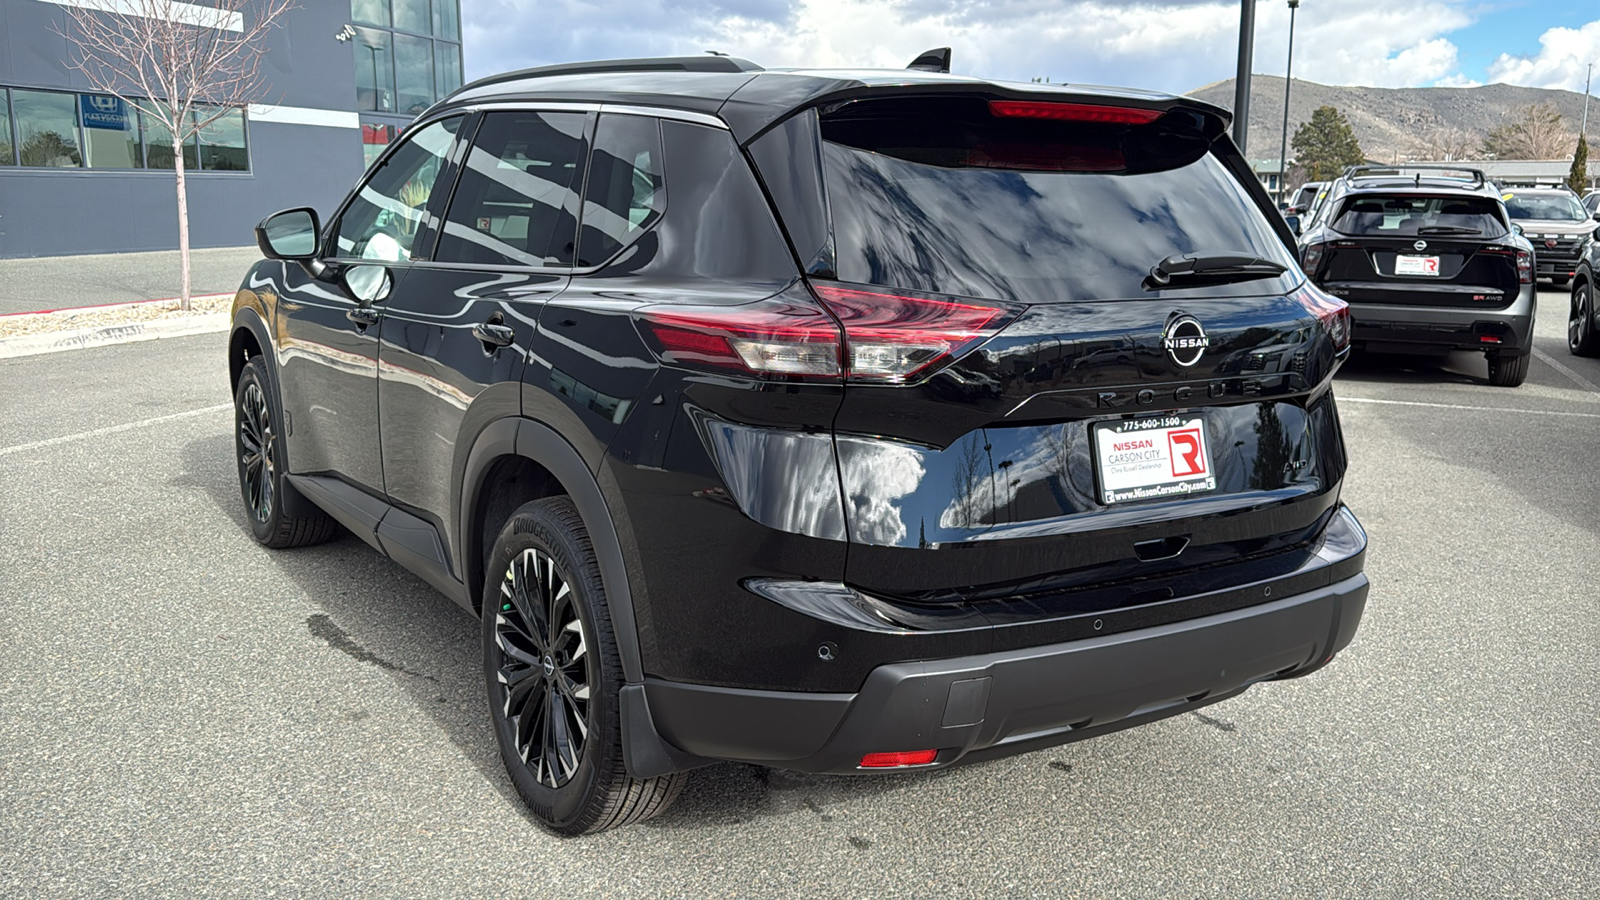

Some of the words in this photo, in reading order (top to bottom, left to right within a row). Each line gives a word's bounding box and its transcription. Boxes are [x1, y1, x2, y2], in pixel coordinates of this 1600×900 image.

[1165, 338, 1209, 349] NISSAN
[1096, 380, 1263, 409] ROGUE
[1123, 416, 1180, 431] 775-600-1500
[1113, 439, 1153, 452] NISSAN
[1108, 451, 1143, 465] CARSON
[1144, 449, 1161, 460] CITY
[1115, 482, 1207, 501] www.NissanCarsonCity.com
[513, 516, 573, 578] BRIDGESTONE
